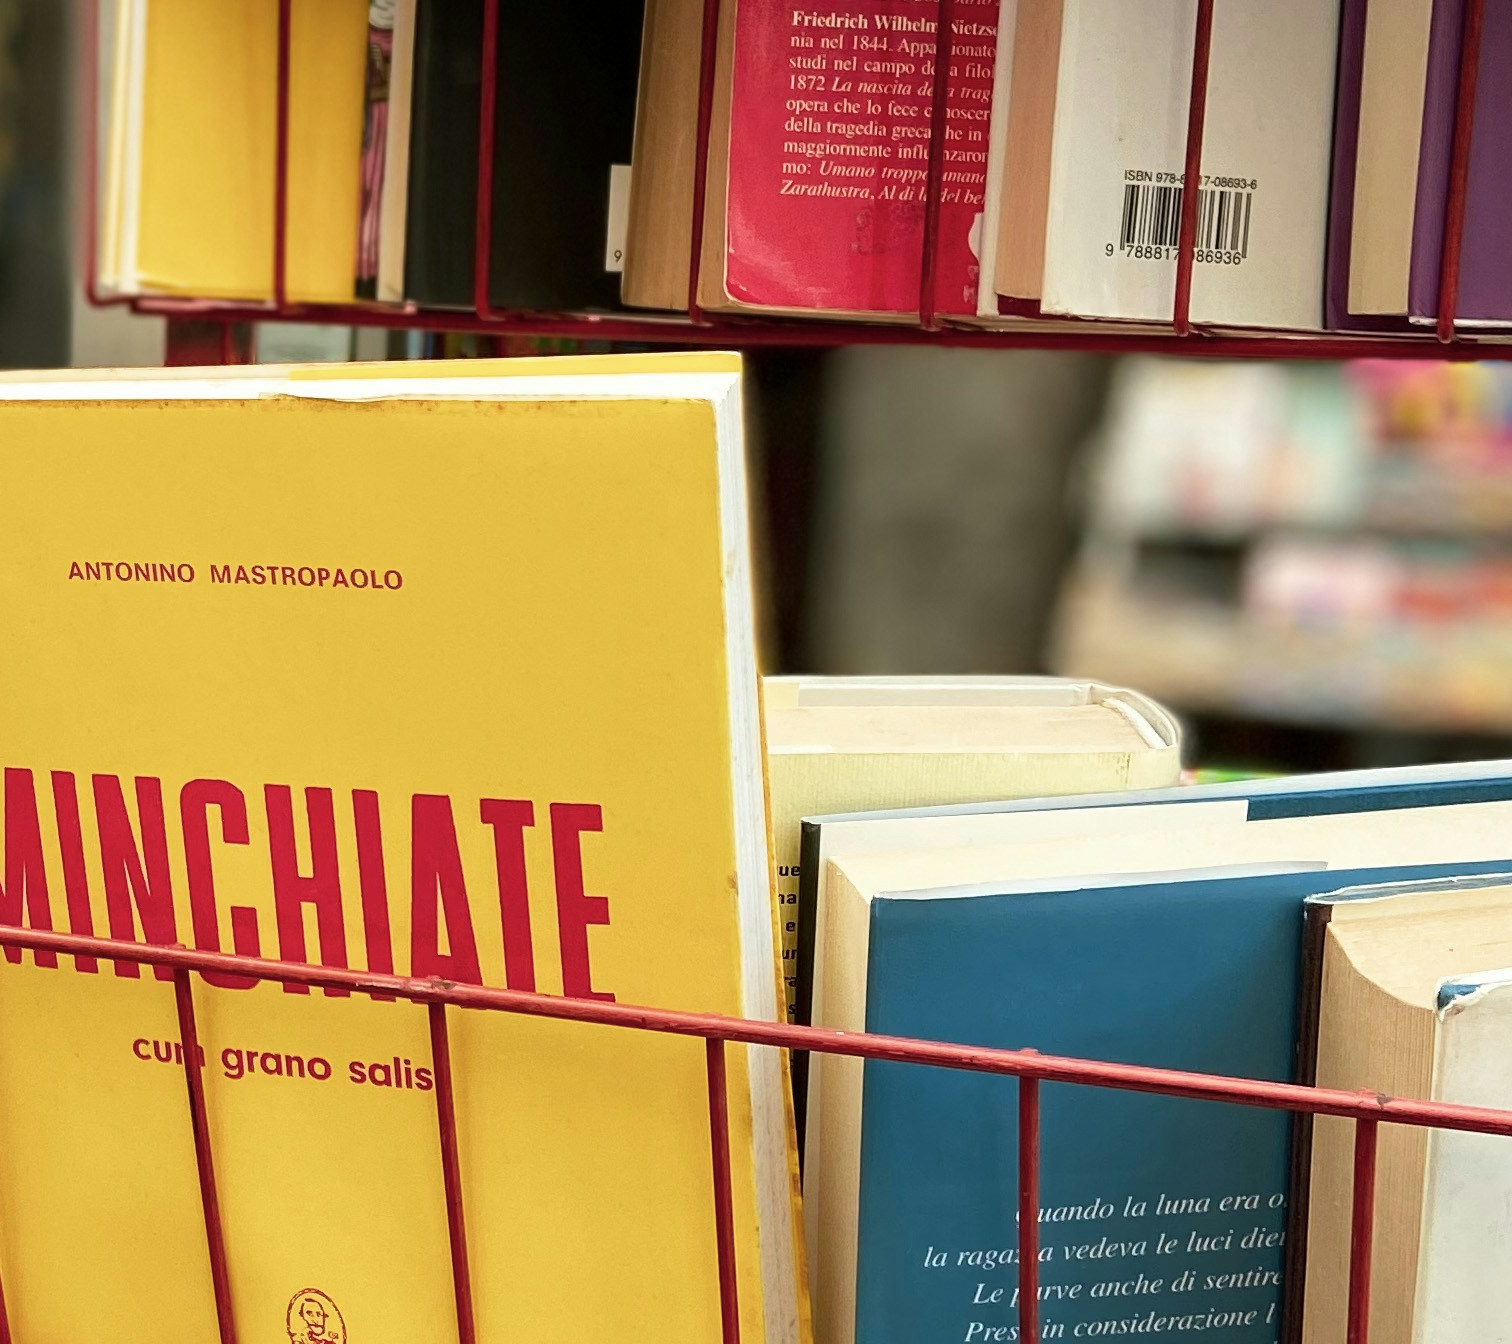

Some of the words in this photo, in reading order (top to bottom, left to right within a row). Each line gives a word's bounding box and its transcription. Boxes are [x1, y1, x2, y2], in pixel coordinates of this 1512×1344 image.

[792, 10, 868, 29] Friedrich
[790, 32, 814, 48] nia
[820, 34, 844, 50] nel
[853, 35, 893, 52] 1844.
[789, 54, 827, 70] studi
[834, 56, 857, 71] nel
[864, 60, 915, 78] campo
[790, 74, 825, 91] 1872
[832, 76, 853, 92] La
[857, 79, 912, 96] nascita
[786, 99, 828, 115] opera
[834, 98, 861, 114] che
[867, 99, 882, 115] lo
[888, 100, 919, 117] fece
[784, 116, 822, 133] della
[827, 120, 887, 138] tragedia
[891, 125, 932, 141] greca
[968, 126, 982, 142] in
[784, 139, 892, 158] maggiormente
[782, 162, 811, 175] mo:
[819, 160, 876, 178] Umano
[1124, 169, 1153, 182] ISBN
[877, 185, 896, 201] Al
[898, 185, 916, 201] di
[1105, 243, 1114, 257] 9
[68, 560, 195, 583] ANTONINO
[209, 563, 404, 591] MASTROPAOLO
[221, 1046, 333, 1082] grano
[348, 1056, 435, 1093] salis
[1016, 1197, 1114, 1225] uando
[1123, 1195, 1147, 1218] la
[1155, 1193, 1211, 1216] luna
[1219, 1194, 1260, 1212] era
[924, 1246, 948, 1268] la
[956, 1246, 1054, 1271] ragaa
[1064, 1236, 1147, 1261] vedeva
[1156, 1233, 1179, 1254] le
[1186, 1229, 1234, 1253] luci
[973, 1283, 1004, 1305] Le
[1090, 1273, 1164, 1299] anche
[1171, 1270, 1197, 1293] di
[1042, 1318, 1065, 1340] in
[1073, 1307, 1258, 1339] considerazione
